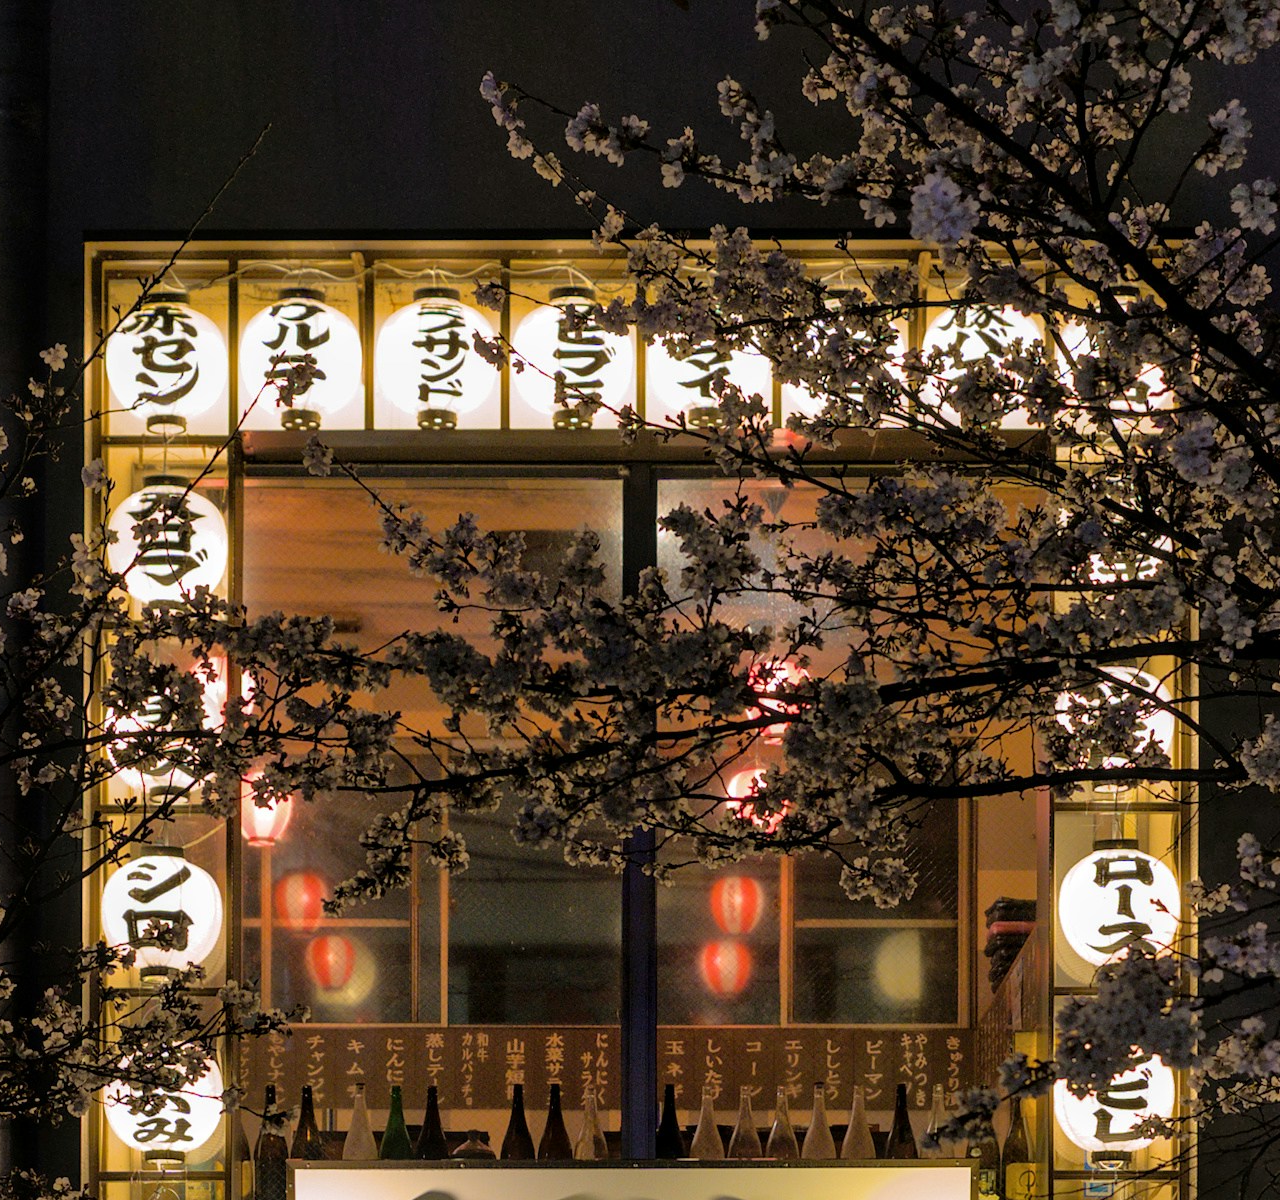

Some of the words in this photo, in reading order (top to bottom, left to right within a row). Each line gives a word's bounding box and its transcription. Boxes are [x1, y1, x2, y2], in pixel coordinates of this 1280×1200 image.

[121, 306, 199, 405] 赤セン
[412, 303, 469, 402] ミノサンド
[122, 863, 194, 951] シロ
[1085, 855, 1157, 954] ロース
[386, 1037, 405, 1085] にんに
[595, 1032, 609, 1105] にんにく
[785, 1040, 803, 1099] エリンギ
[826, 1039, 841, 1101] ししとう
[914, 1033, 928, 1107] やみつき
[1093, 1052, 1154, 1143] ビレ
